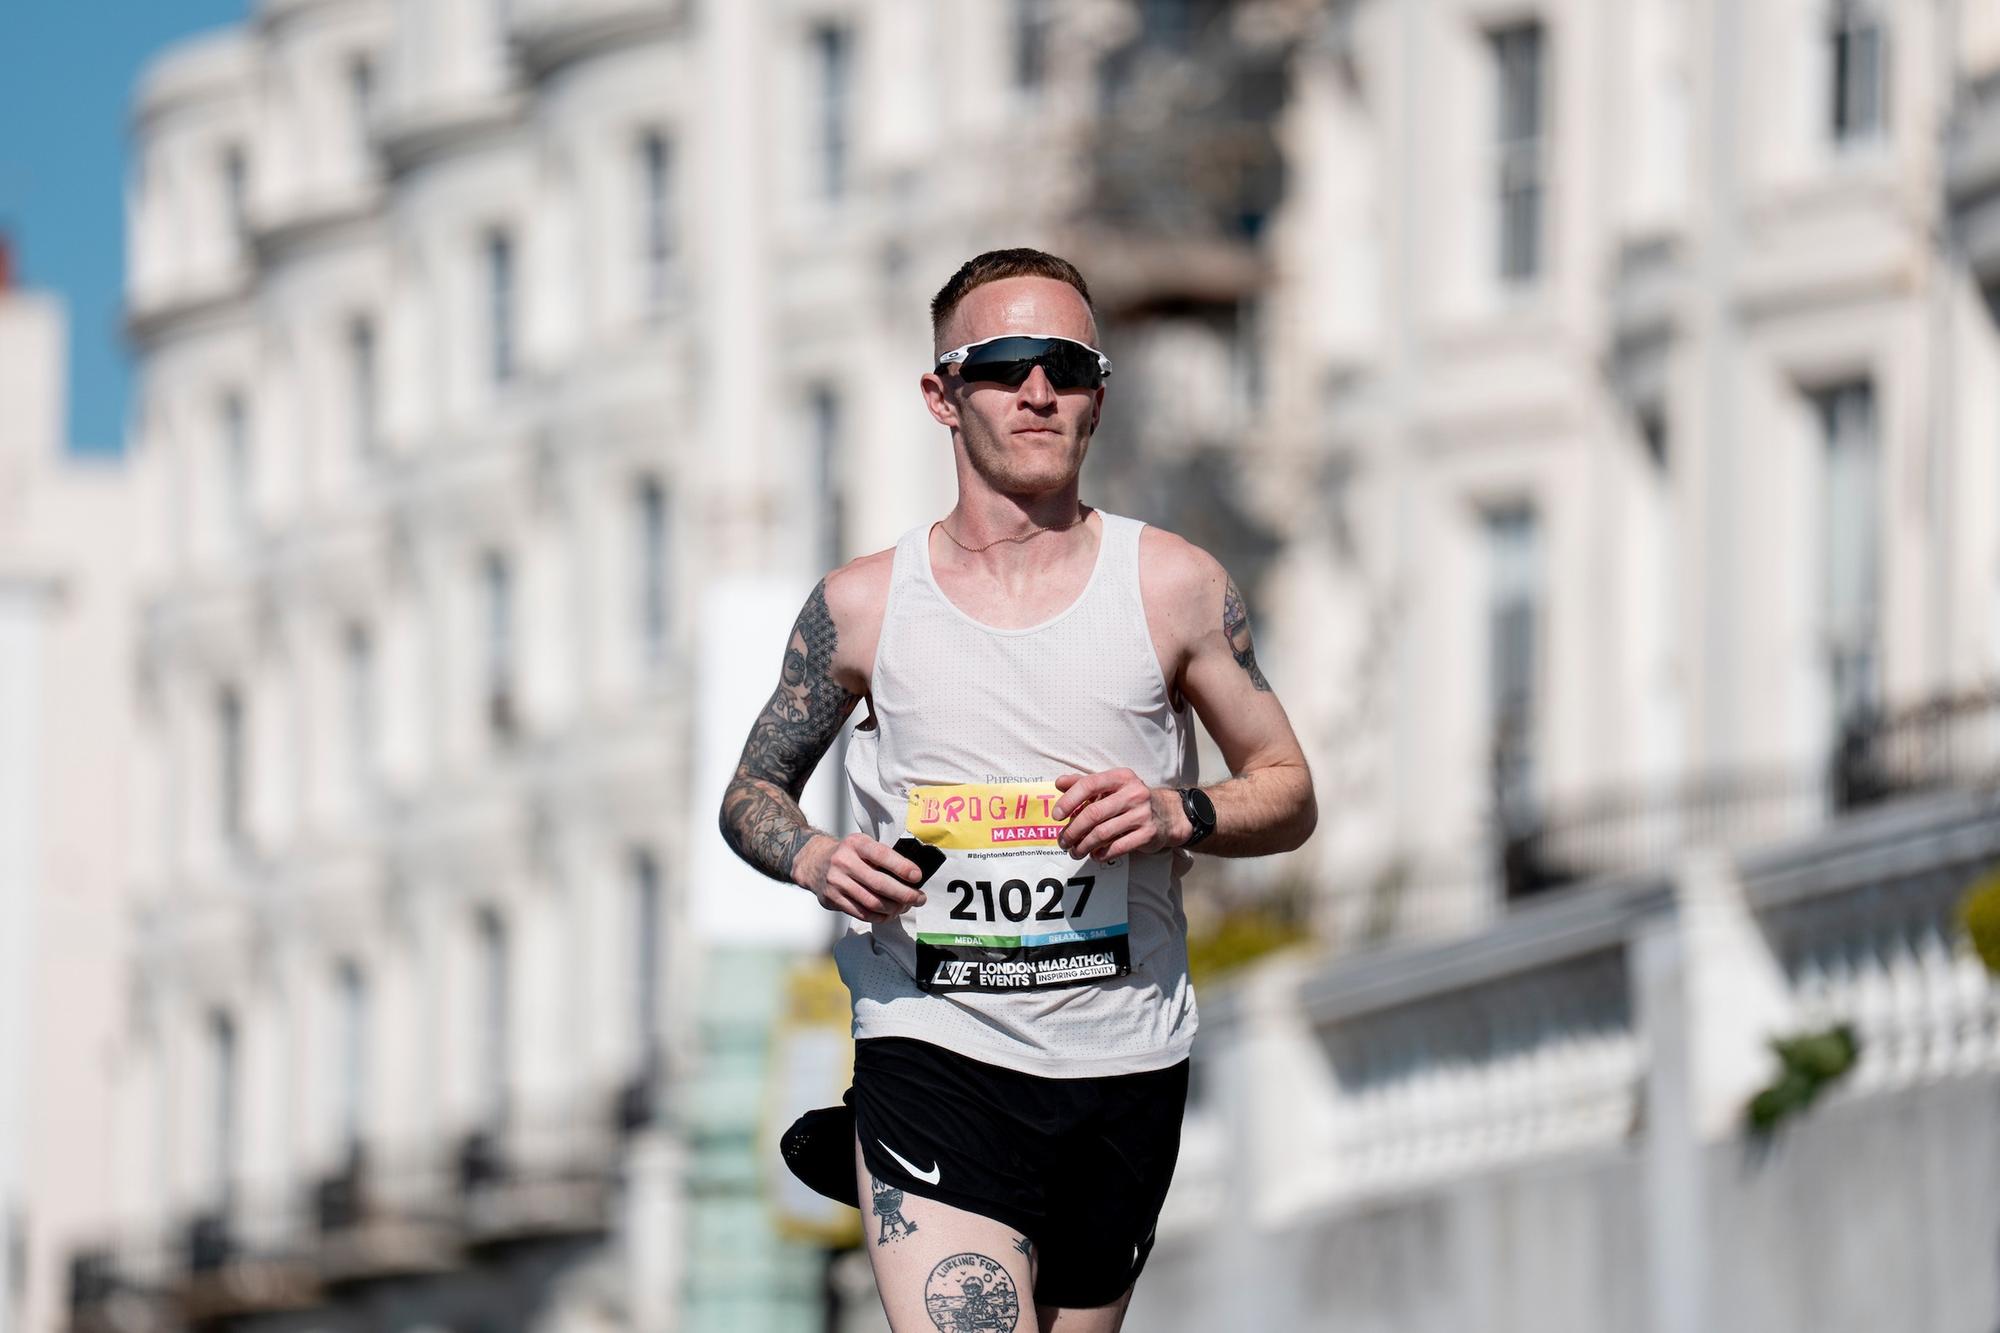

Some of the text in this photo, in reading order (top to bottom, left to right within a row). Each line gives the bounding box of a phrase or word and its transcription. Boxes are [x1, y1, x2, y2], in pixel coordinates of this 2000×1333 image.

[920, 794, 1056, 824] BRIGHT
[993, 827, 1064, 841] MARATH
[947, 876, 1096, 923] 21027
[954, 935, 983, 945] MEDAL
[979, 952, 1115, 975] LONDON MARATHON
[980, 974, 1030, 987] EVENTS
[1038, 966, 1113, 982] INSPIRING ACTIVITY
[936, 1256, 1000, 1278] LURKING FOR
